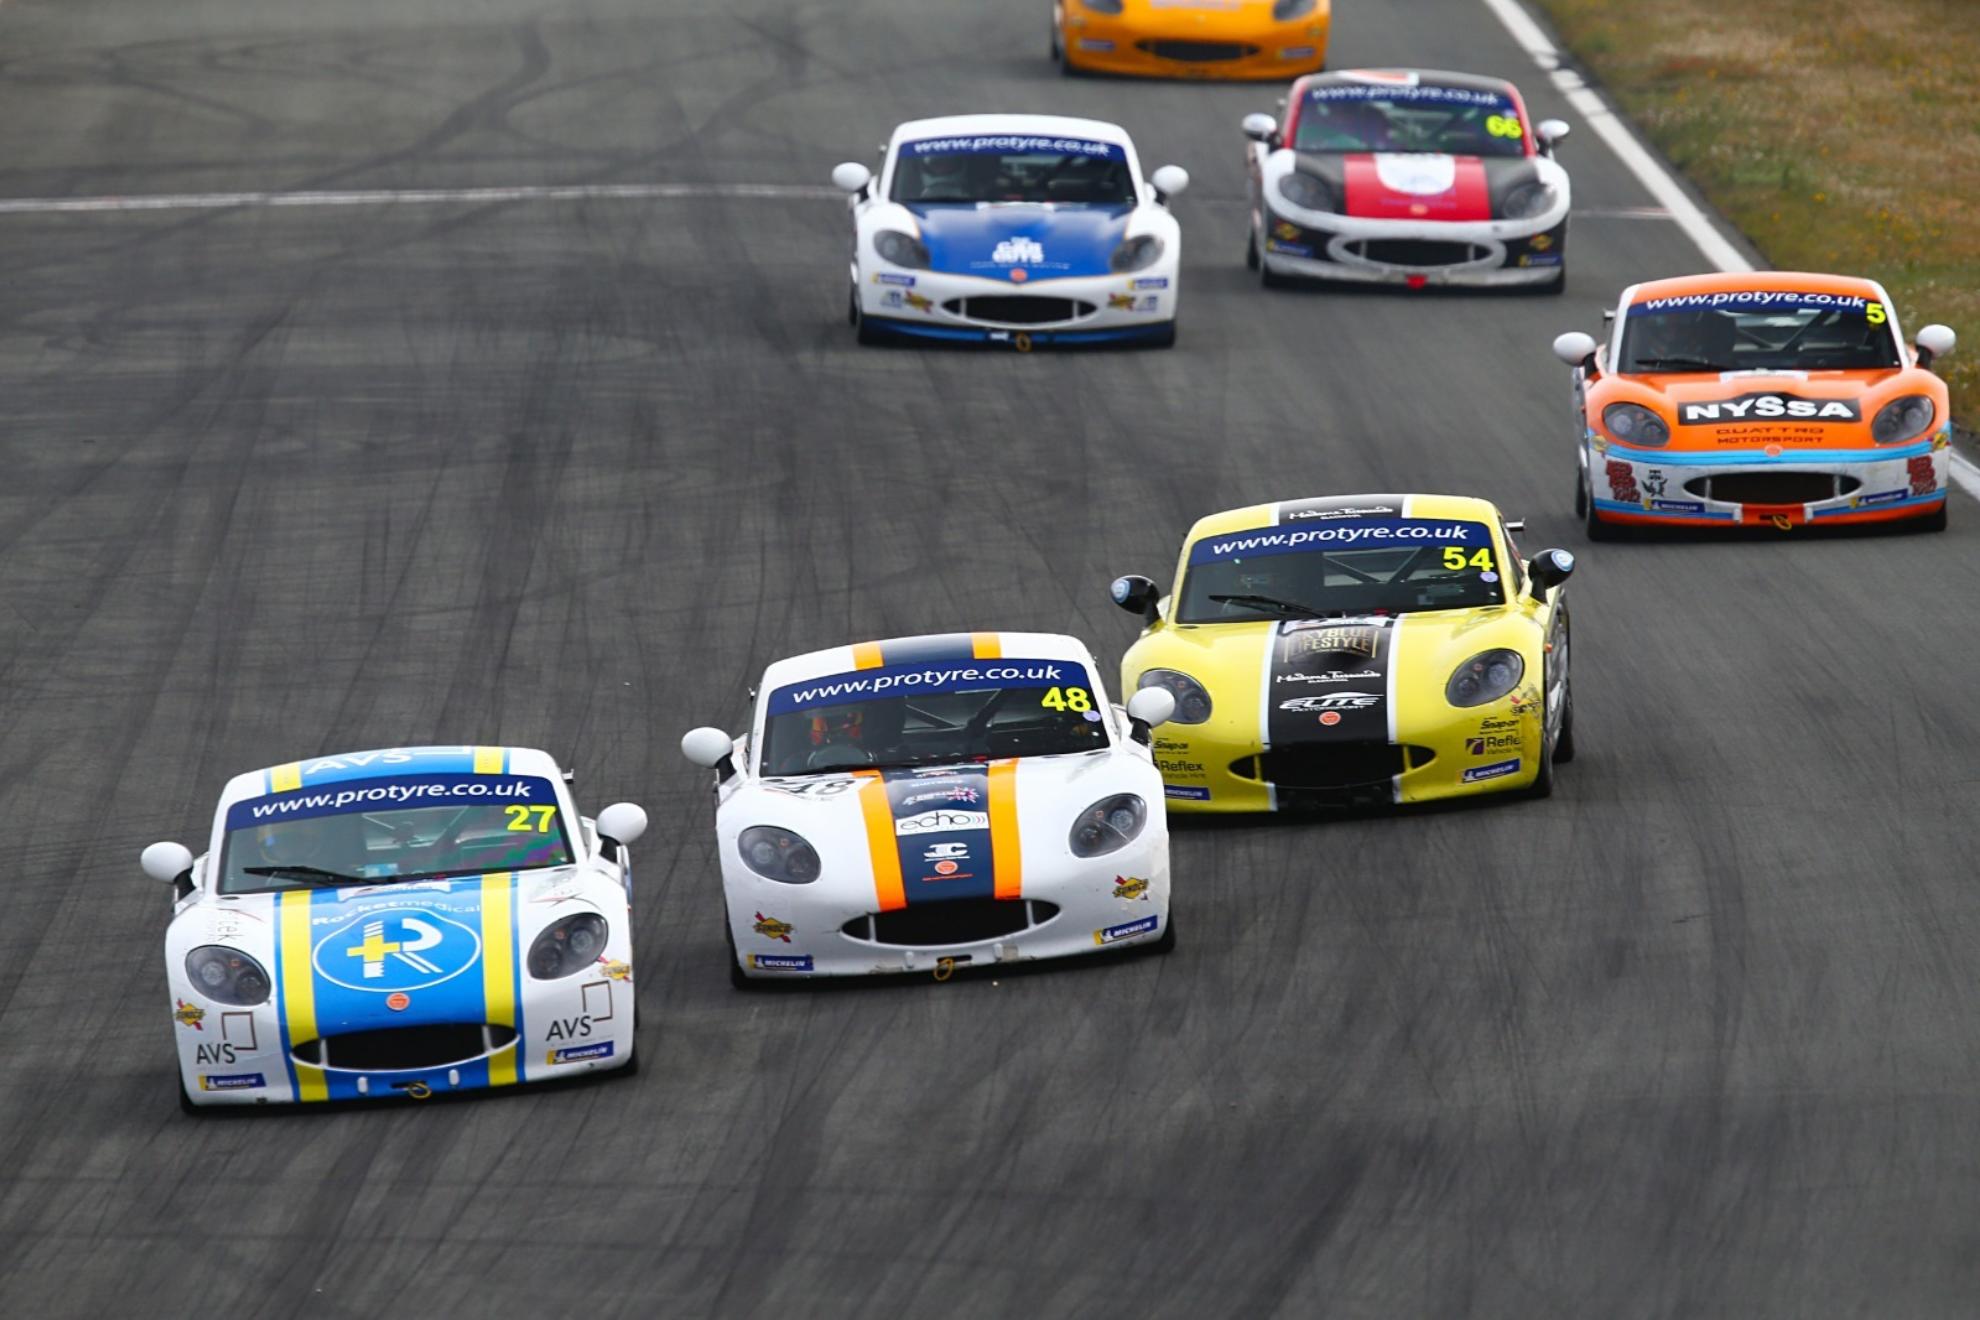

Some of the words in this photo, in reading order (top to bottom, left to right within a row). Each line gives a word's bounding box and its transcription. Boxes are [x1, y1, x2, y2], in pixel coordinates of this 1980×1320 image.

[1486, 114, 1523, 139] 66
[914, 135, 1110, 157] www.protyre.co.uk
[1646, 290, 1865, 310] www.protyre.co.uk
[1865, 302, 1887, 325] 5
[1685, 395, 1854, 420] NYSSA
[1716, 427, 1825, 435] QUATTRO
[1717, 436, 1824, 445] MOTORSPORT
[1211, 523, 1469, 555] www.protyre.co.uk
[1443, 546, 1495, 573] 54
[792, 664, 1064, 704] www.protyre.co.uk
[1040, 686, 1092, 713] 48
[303, 750, 415, 776] AVS
[1160, 759, 1204, 772] Reflex
[251, 780, 533, 819] www.protyre.co.uk
[503, 804, 558, 833] 27
[900, 811, 971, 829] echo
[545, 1014, 592, 1042] AVS
[195, 1042, 237, 1065] AVS
